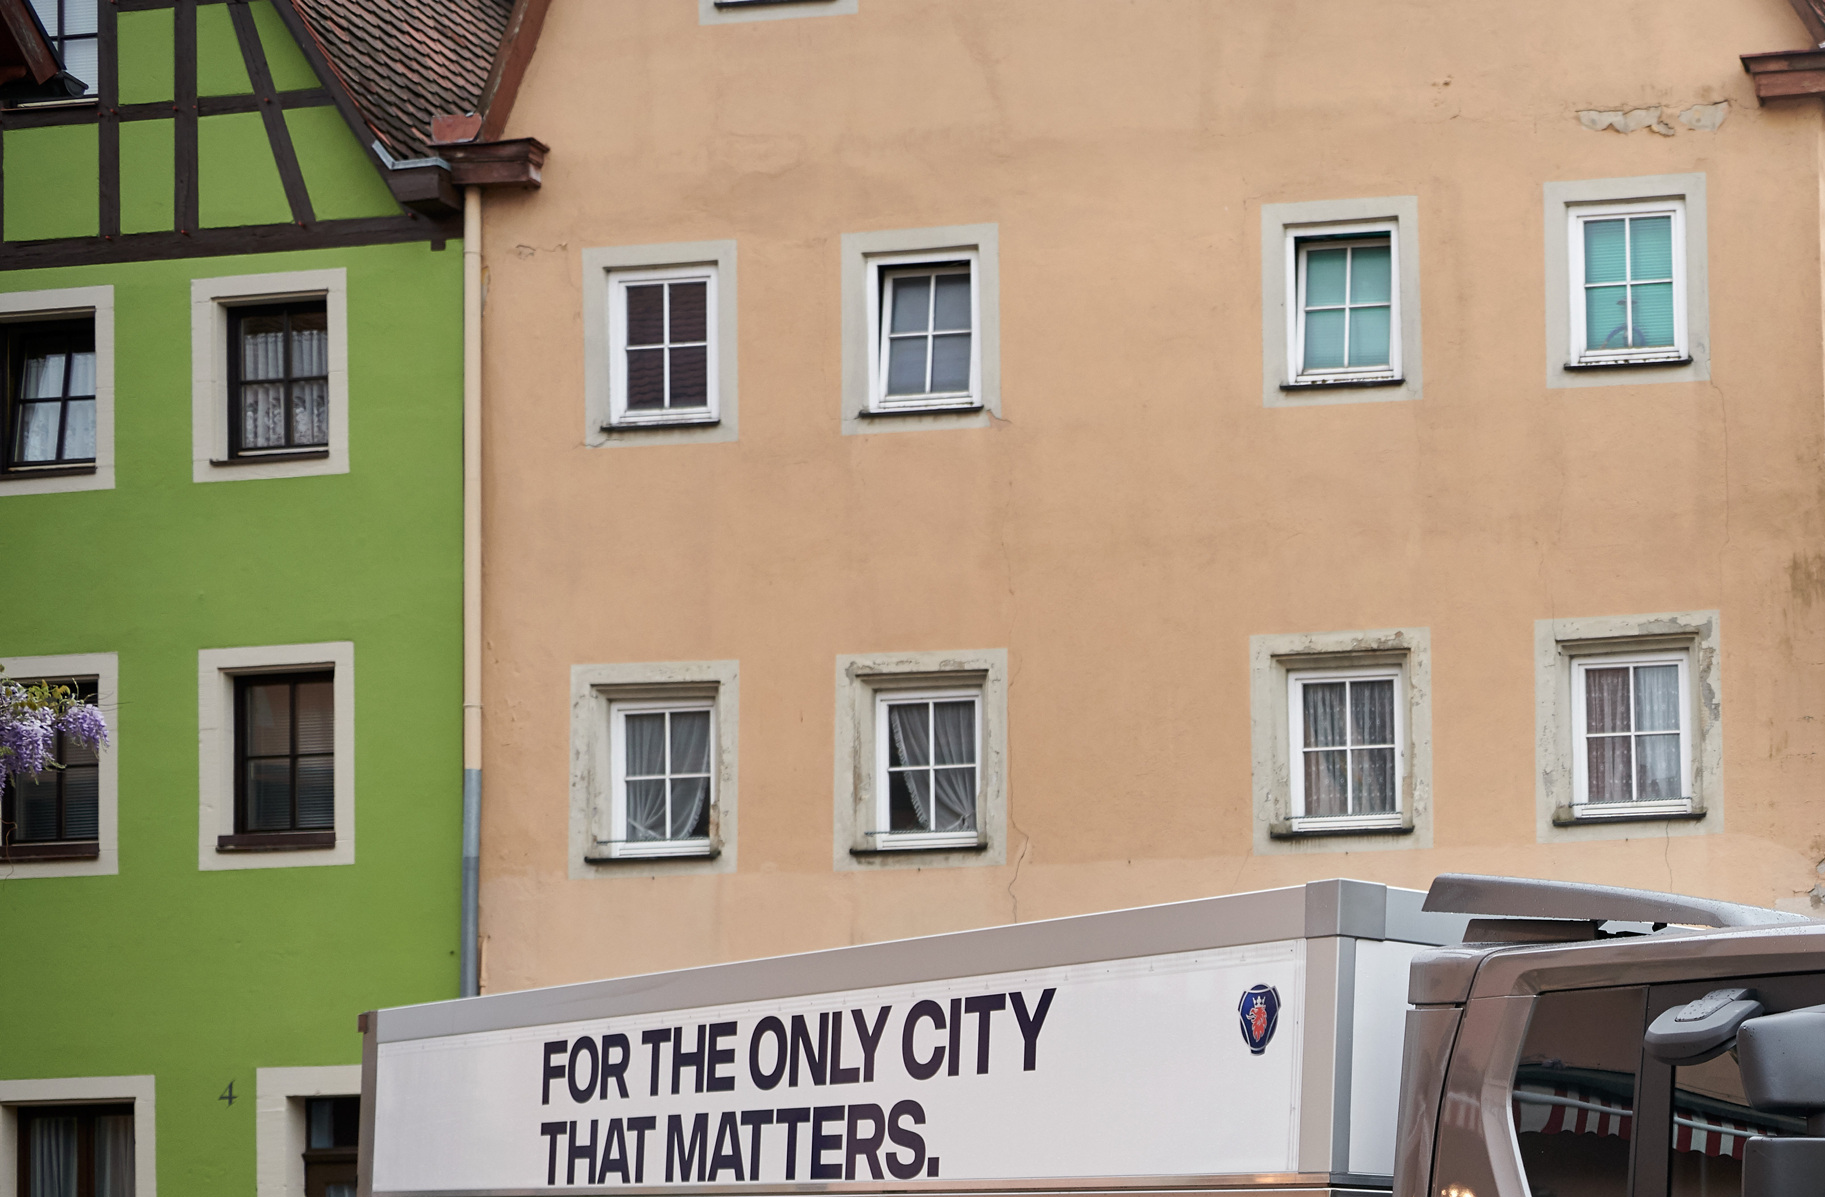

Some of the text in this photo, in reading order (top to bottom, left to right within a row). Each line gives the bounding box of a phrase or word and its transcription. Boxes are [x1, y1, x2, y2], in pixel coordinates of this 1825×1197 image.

[542, 988, 1057, 1105] FOR THE ONLY CITY
[218, 1079, 239, 1110] 4
[541, 1099, 940, 1186] THAT MATTERS.
